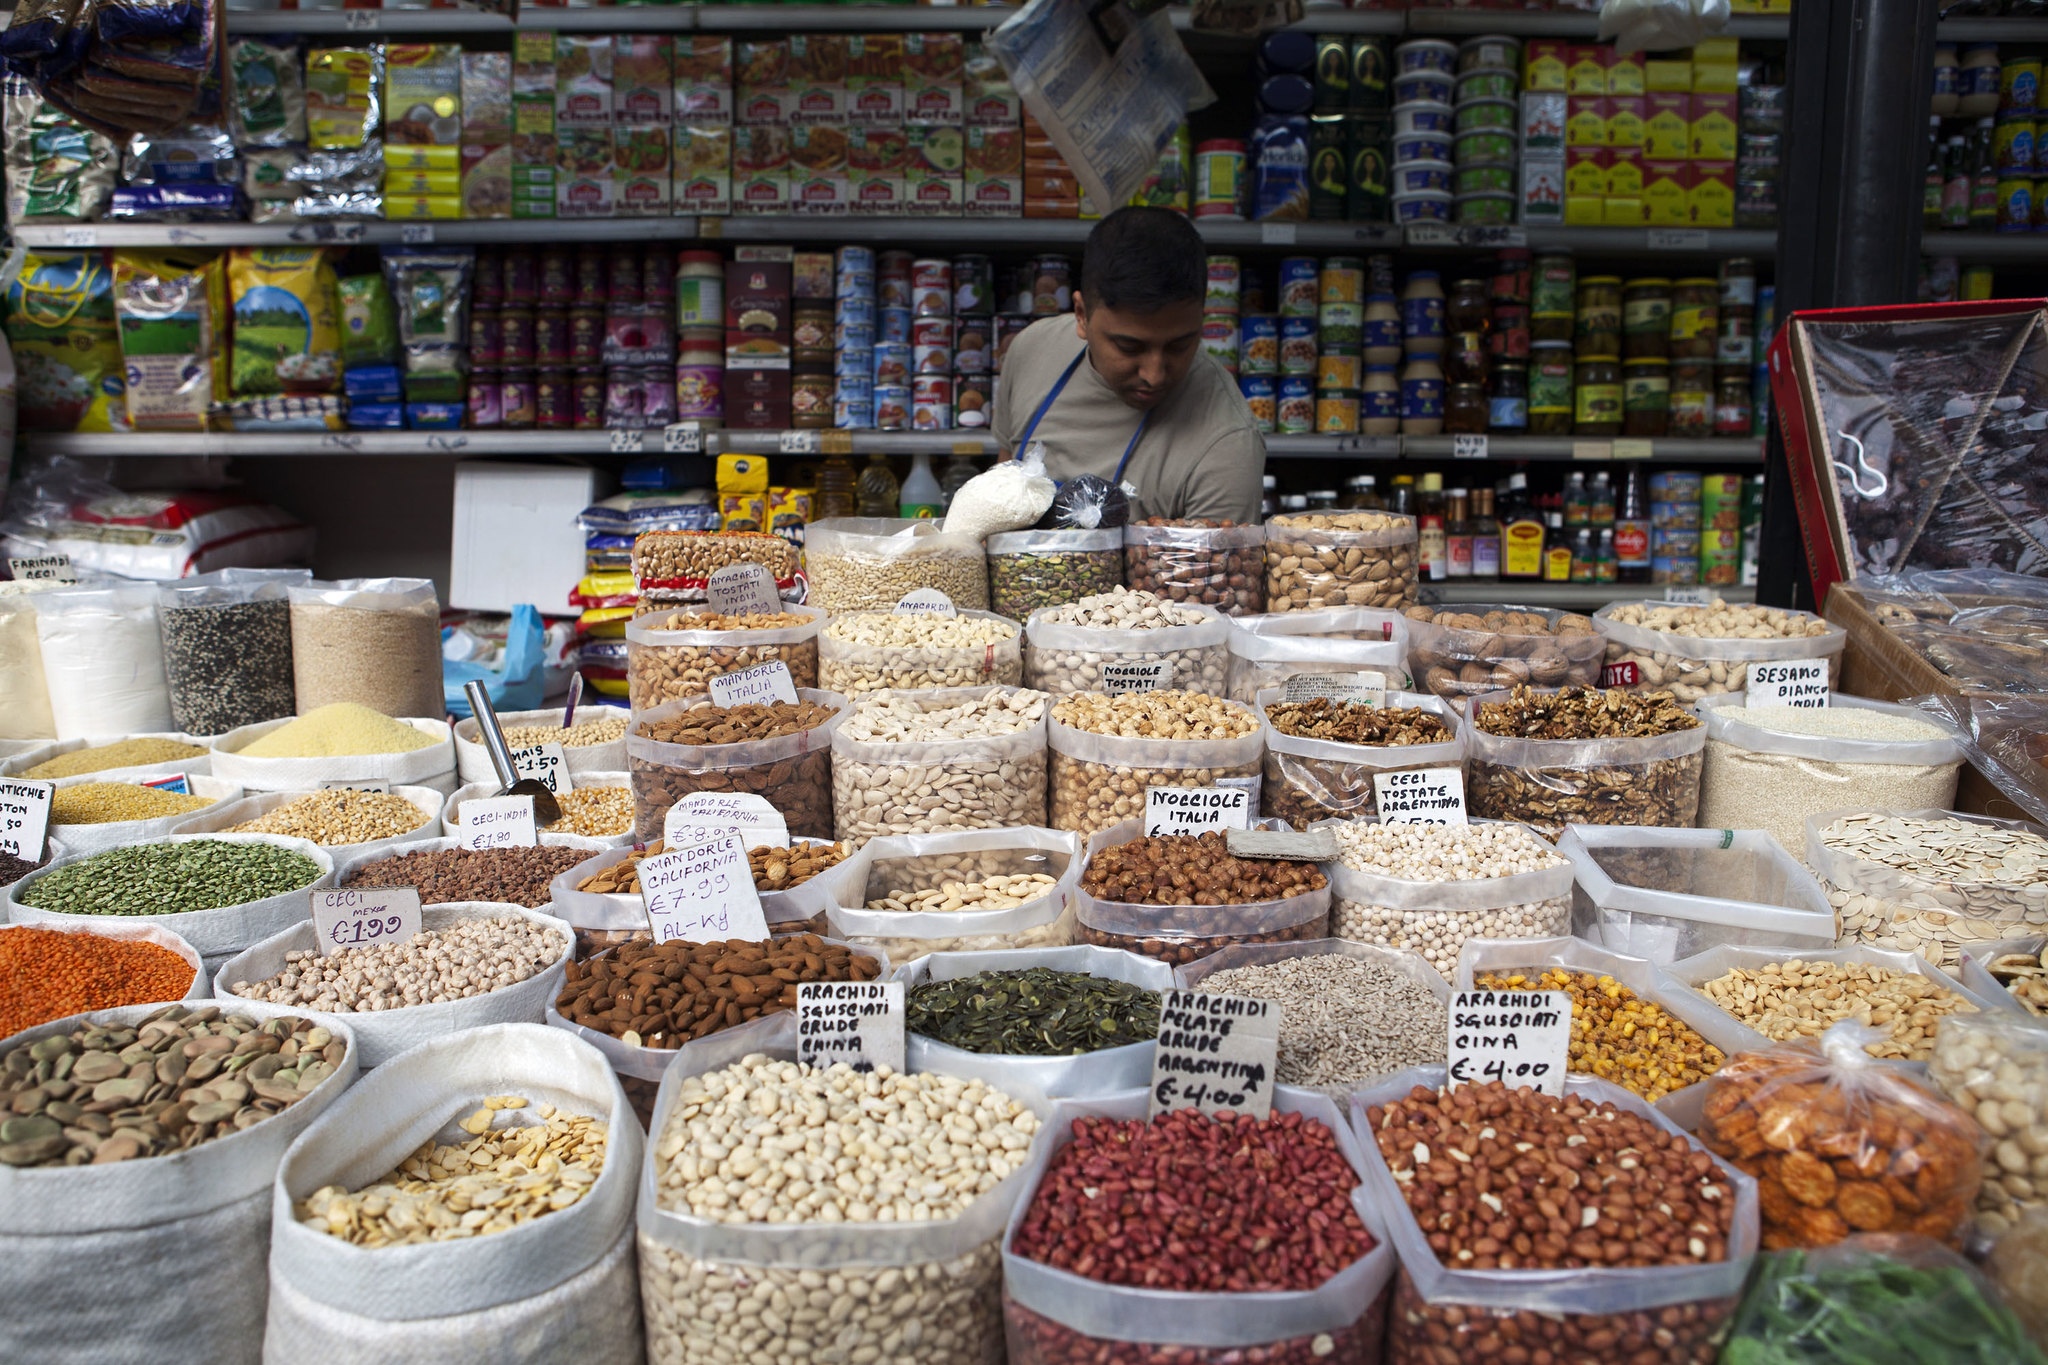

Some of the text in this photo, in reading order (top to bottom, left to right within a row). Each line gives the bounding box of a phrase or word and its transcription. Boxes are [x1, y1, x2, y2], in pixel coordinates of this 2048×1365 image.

[711, 568, 764, 586] ANACARDI
[714, 581, 760, 596] TOSTATI
[726, 591, 757, 606] INDIA
[900, 602, 949, 612] ANACARDI
[715, 662, 784, 688] MANDORLE
[1104, 666, 1161, 676] NOCCIOLE
[1755, 667, 1820, 683] SESAMO
[727, 679, 772, 700] ITALIA
[1105, 679, 1155, 689] TOSTATI
[1778, 684, 1829, 697] BIANCO
[1390, 773, 1426, 786] CECI
[1153, 791, 1245, 808] NOCCIOLE
[1382, 785, 1447, 800] TOSTATE
[678, 799, 741, 811] MANDORLE
[1170, 810, 1219, 823] ITALIA
[646, 838, 734, 871] MANDORLE
[648, 850, 738, 890] CALIFORNIA
[325, 890, 363, 908] CECI
[801, 984, 885, 999] ARACHIDI
[1168, 990, 1267, 1017] ARACHIDI
[1456, 992, 1550, 1008] ARACHIDI
[802, 998, 889, 1019] SGUSCIATI
[800, 1018, 860, 1036] CRUDE
[1162, 1009, 1234, 1036] PELATE
[1455, 1010, 1561, 1029] SGUSCIATI
[802, 1036, 862, 1053] CHINA
[1159, 1029, 1222, 1053] CRUDE
[1455, 1033, 1518, 1049] CINA
